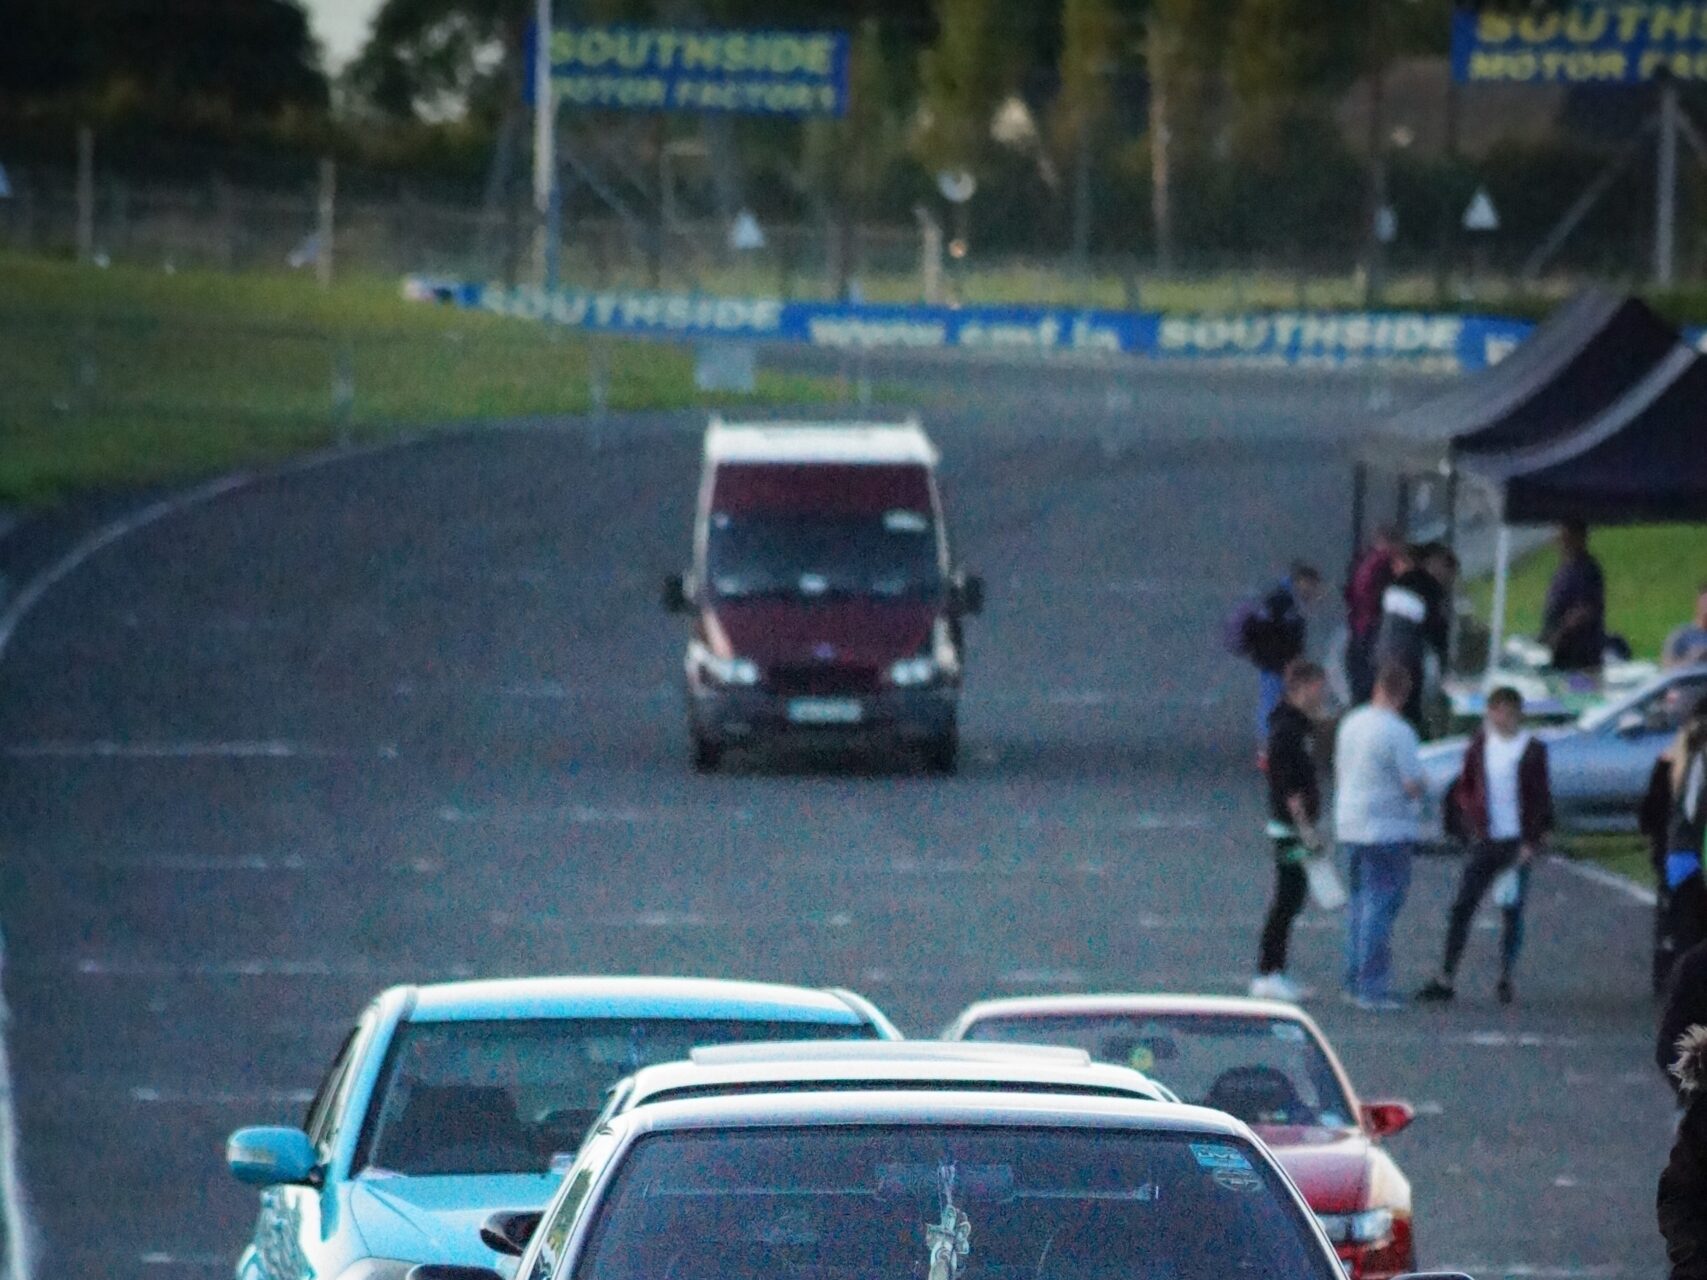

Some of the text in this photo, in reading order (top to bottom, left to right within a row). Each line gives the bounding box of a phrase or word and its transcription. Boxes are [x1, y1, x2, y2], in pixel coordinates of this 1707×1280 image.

[1477, 4, 1707, 43] SOUTH
[550, 28, 833, 74] SOUTHSIDE
[1469, 50, 1627, 81] MOTOR
[481, 281, 783, 330] SOUTHSIDE
[1160, 314, 1463, 351] SOUTHSIDE
